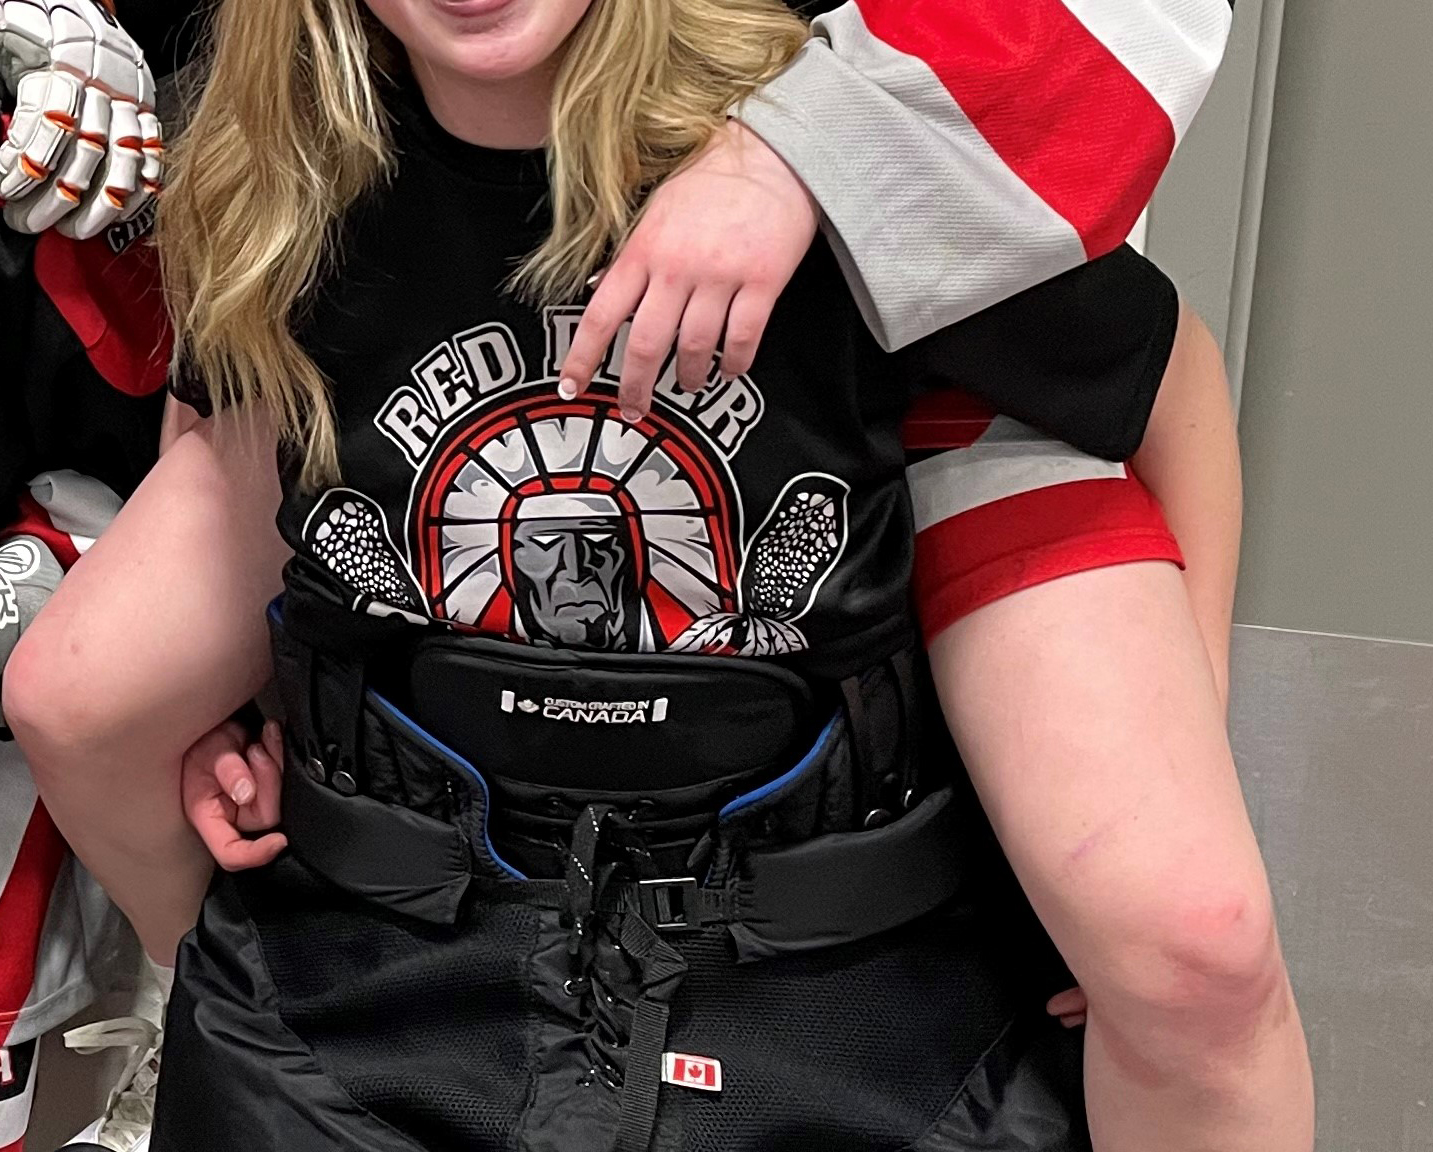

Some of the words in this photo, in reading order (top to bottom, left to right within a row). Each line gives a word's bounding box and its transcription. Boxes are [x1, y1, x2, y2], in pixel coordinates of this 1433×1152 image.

[373, 322, 525, 466] RED
[542, 705, 647, 724] CANADA
[637, 700, 650, 710] IN
